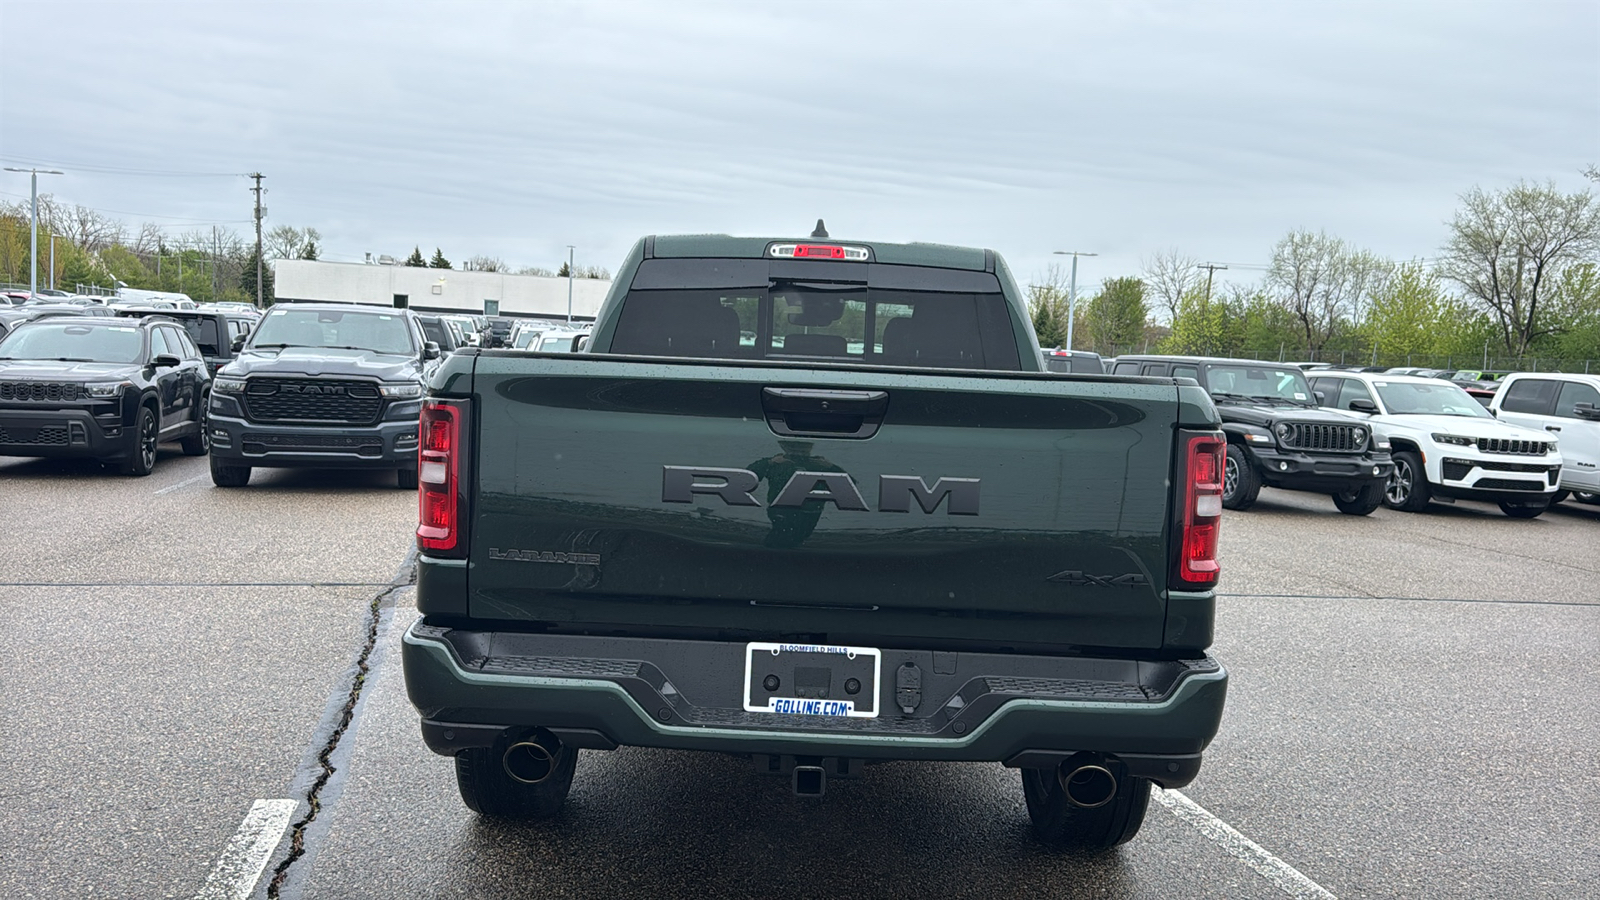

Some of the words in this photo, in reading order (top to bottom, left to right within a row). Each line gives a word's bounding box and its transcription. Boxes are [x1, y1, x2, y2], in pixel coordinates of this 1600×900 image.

[280, 384, 345, 394] RAM
[661, 464, 981, 516] RAM
[489, 547, 601, 566] LARAMIE
[779, 645, 825, 653] BLOOMFIELD
[774, 699, 848, 717] GOLLING.COM
